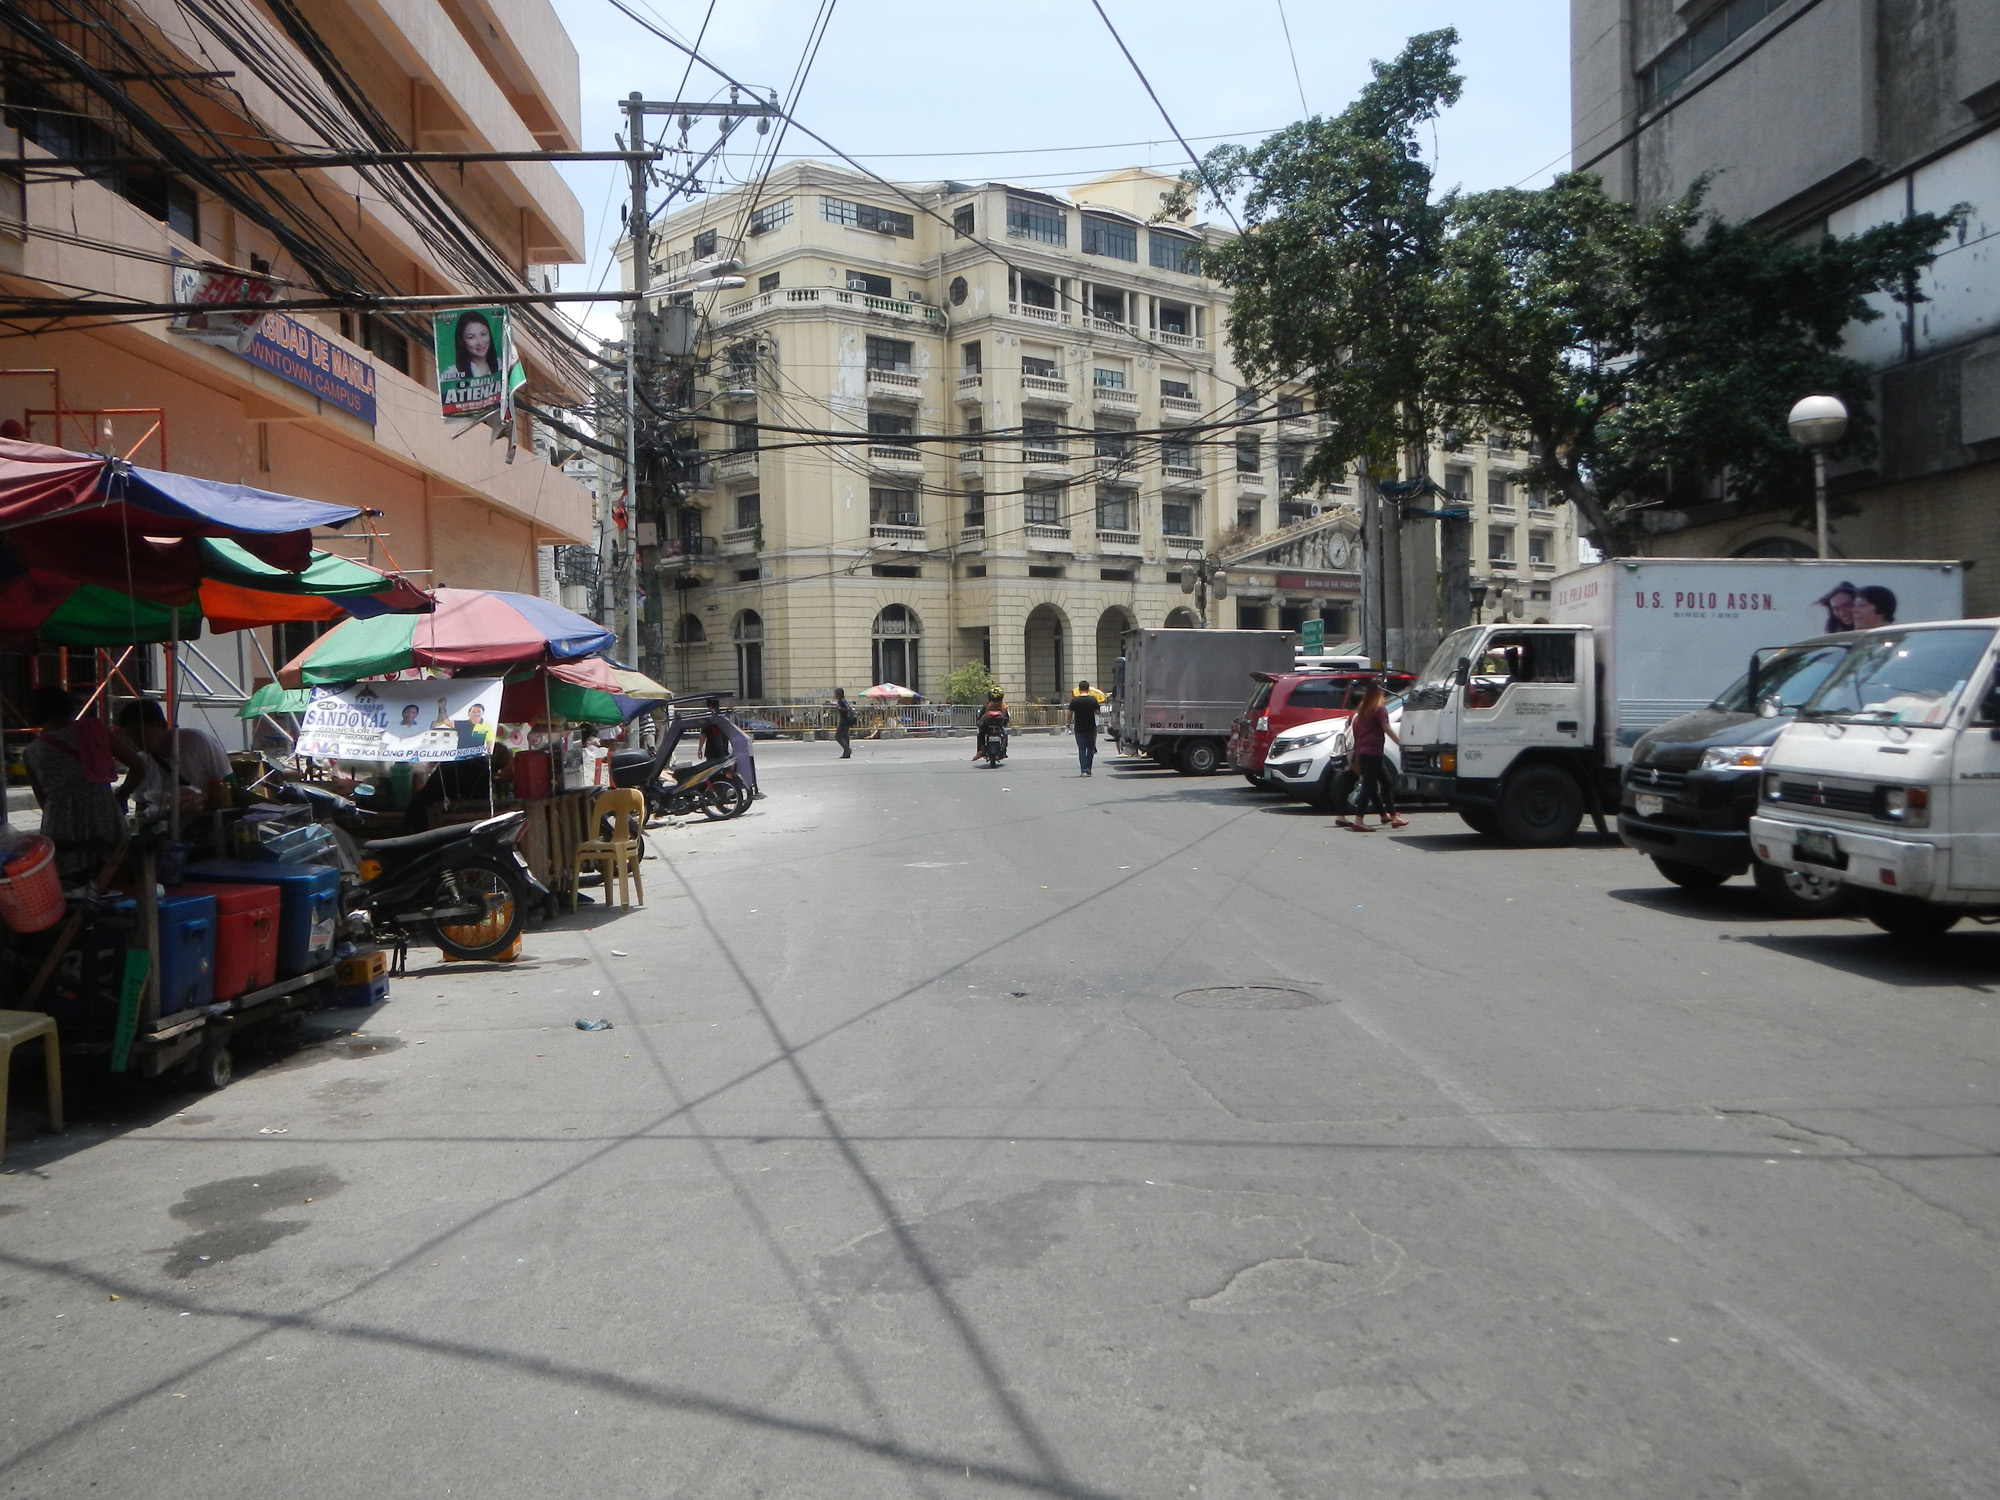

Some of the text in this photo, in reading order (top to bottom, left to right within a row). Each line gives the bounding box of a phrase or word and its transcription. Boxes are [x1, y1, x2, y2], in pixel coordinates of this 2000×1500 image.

[311, 334, 330, 372] DE
[331, 346, 376, 398] MANILA
[316, 374, 361, 411] CAMPUS
[444, 381, 502, 405] ATIENZA
[1635, 592, 1777, 611] U.S. POLO ASSN.
[319, 702, 336, 710] 26
[306, 710, 389, 729] SANDOVAL
[345, 748, 360, 757] KO
[361, 748, 404, 758] KAYONG
